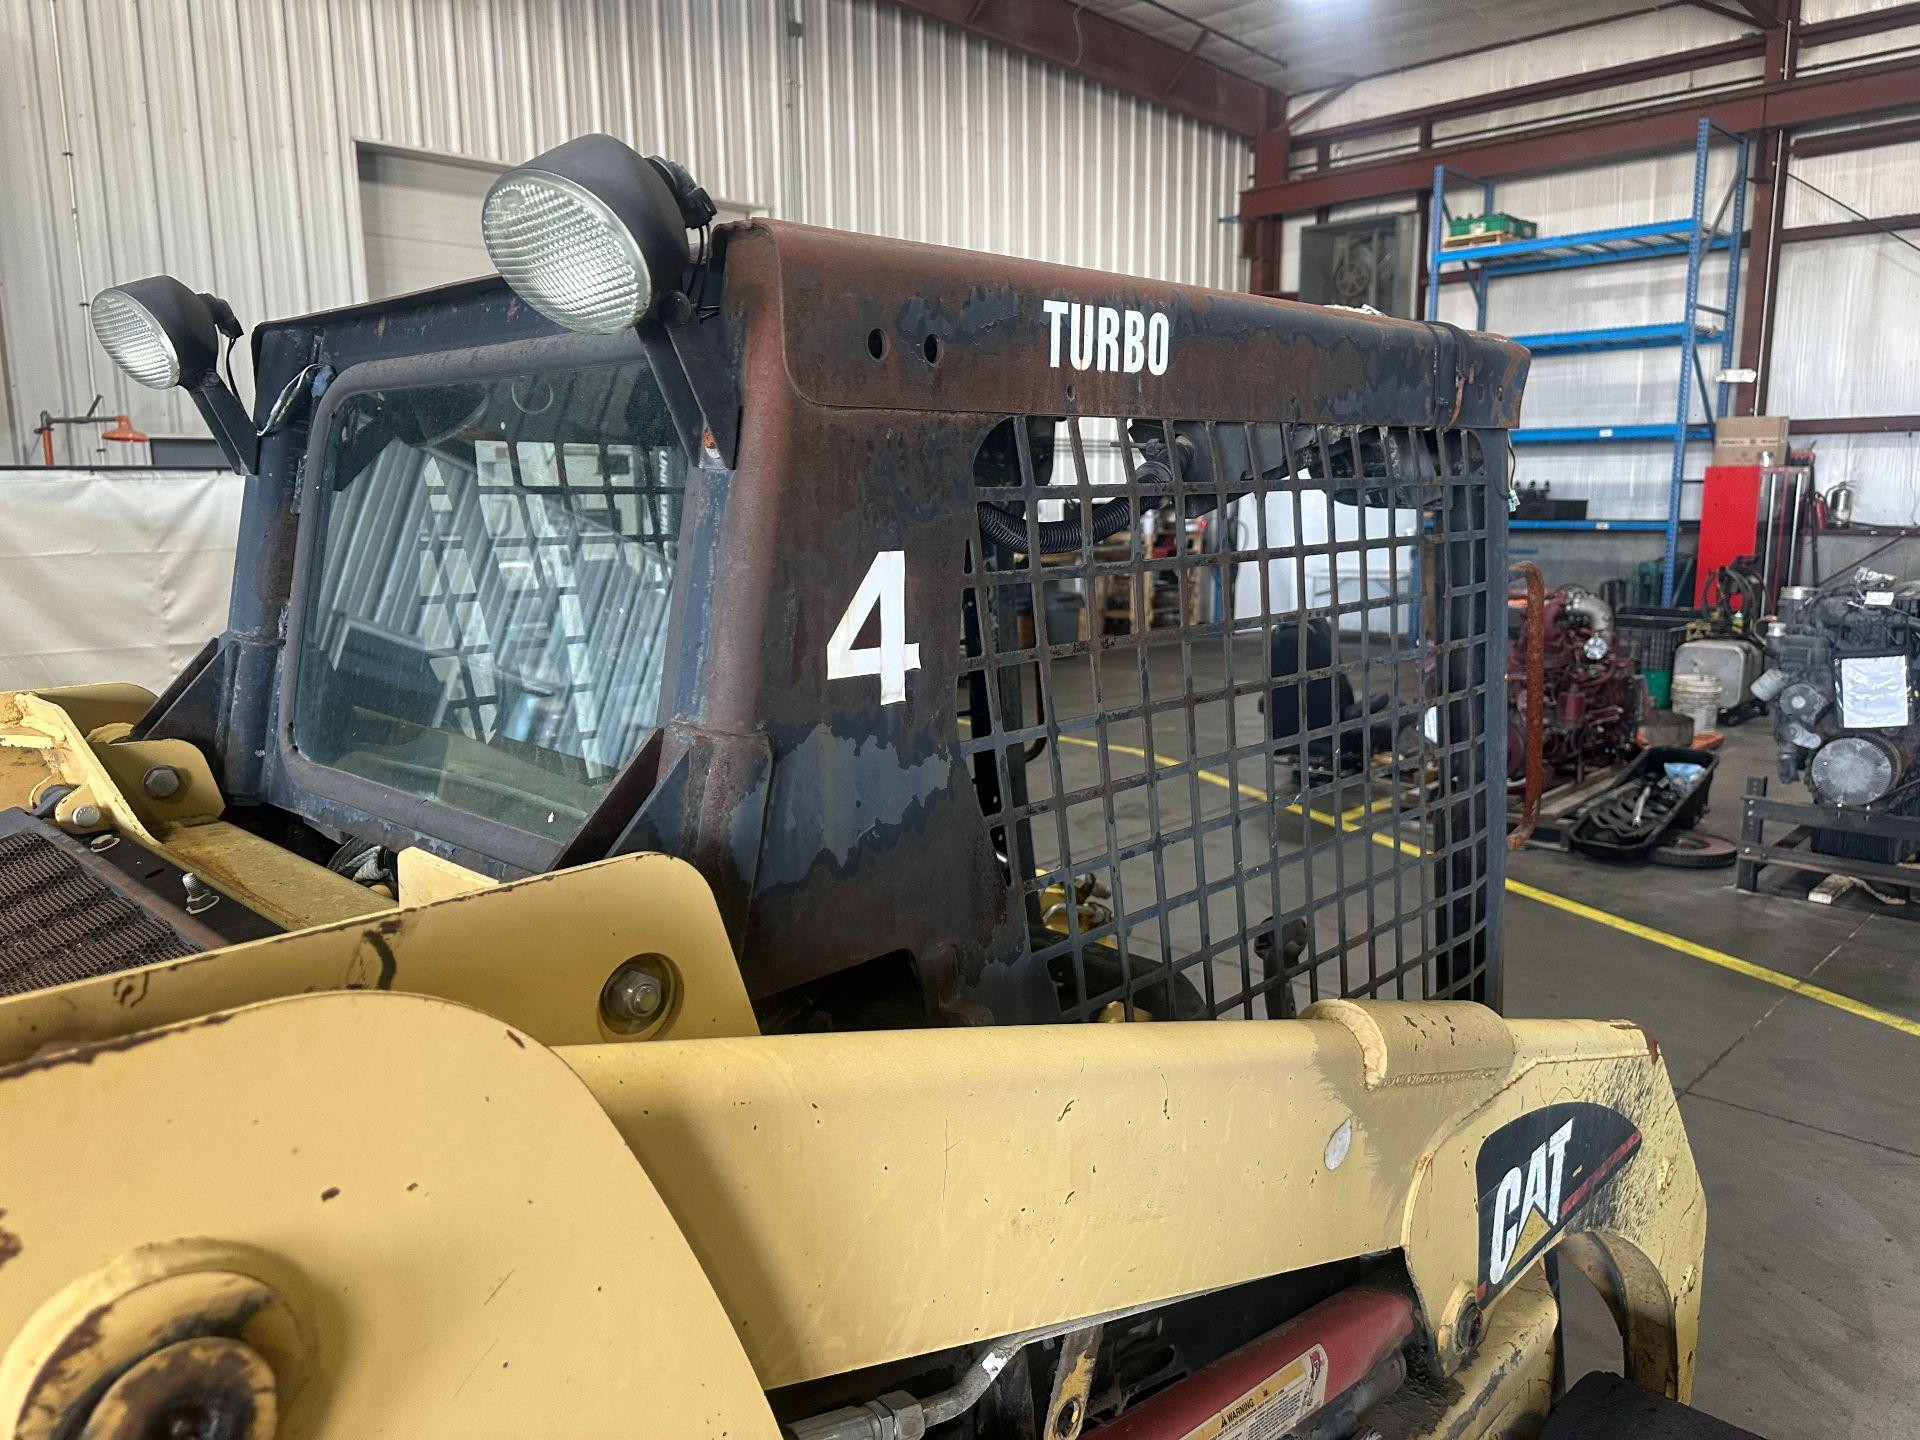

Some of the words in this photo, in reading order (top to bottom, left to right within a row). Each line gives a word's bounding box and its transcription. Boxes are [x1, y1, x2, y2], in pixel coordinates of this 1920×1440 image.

[1043, 300, 1169, 376] TURBO
[827, 550, 921, 705] 4
[1490, 1117, 1573, 1284] CAT
[1226, 1398, 1254, 1422] WARNING
